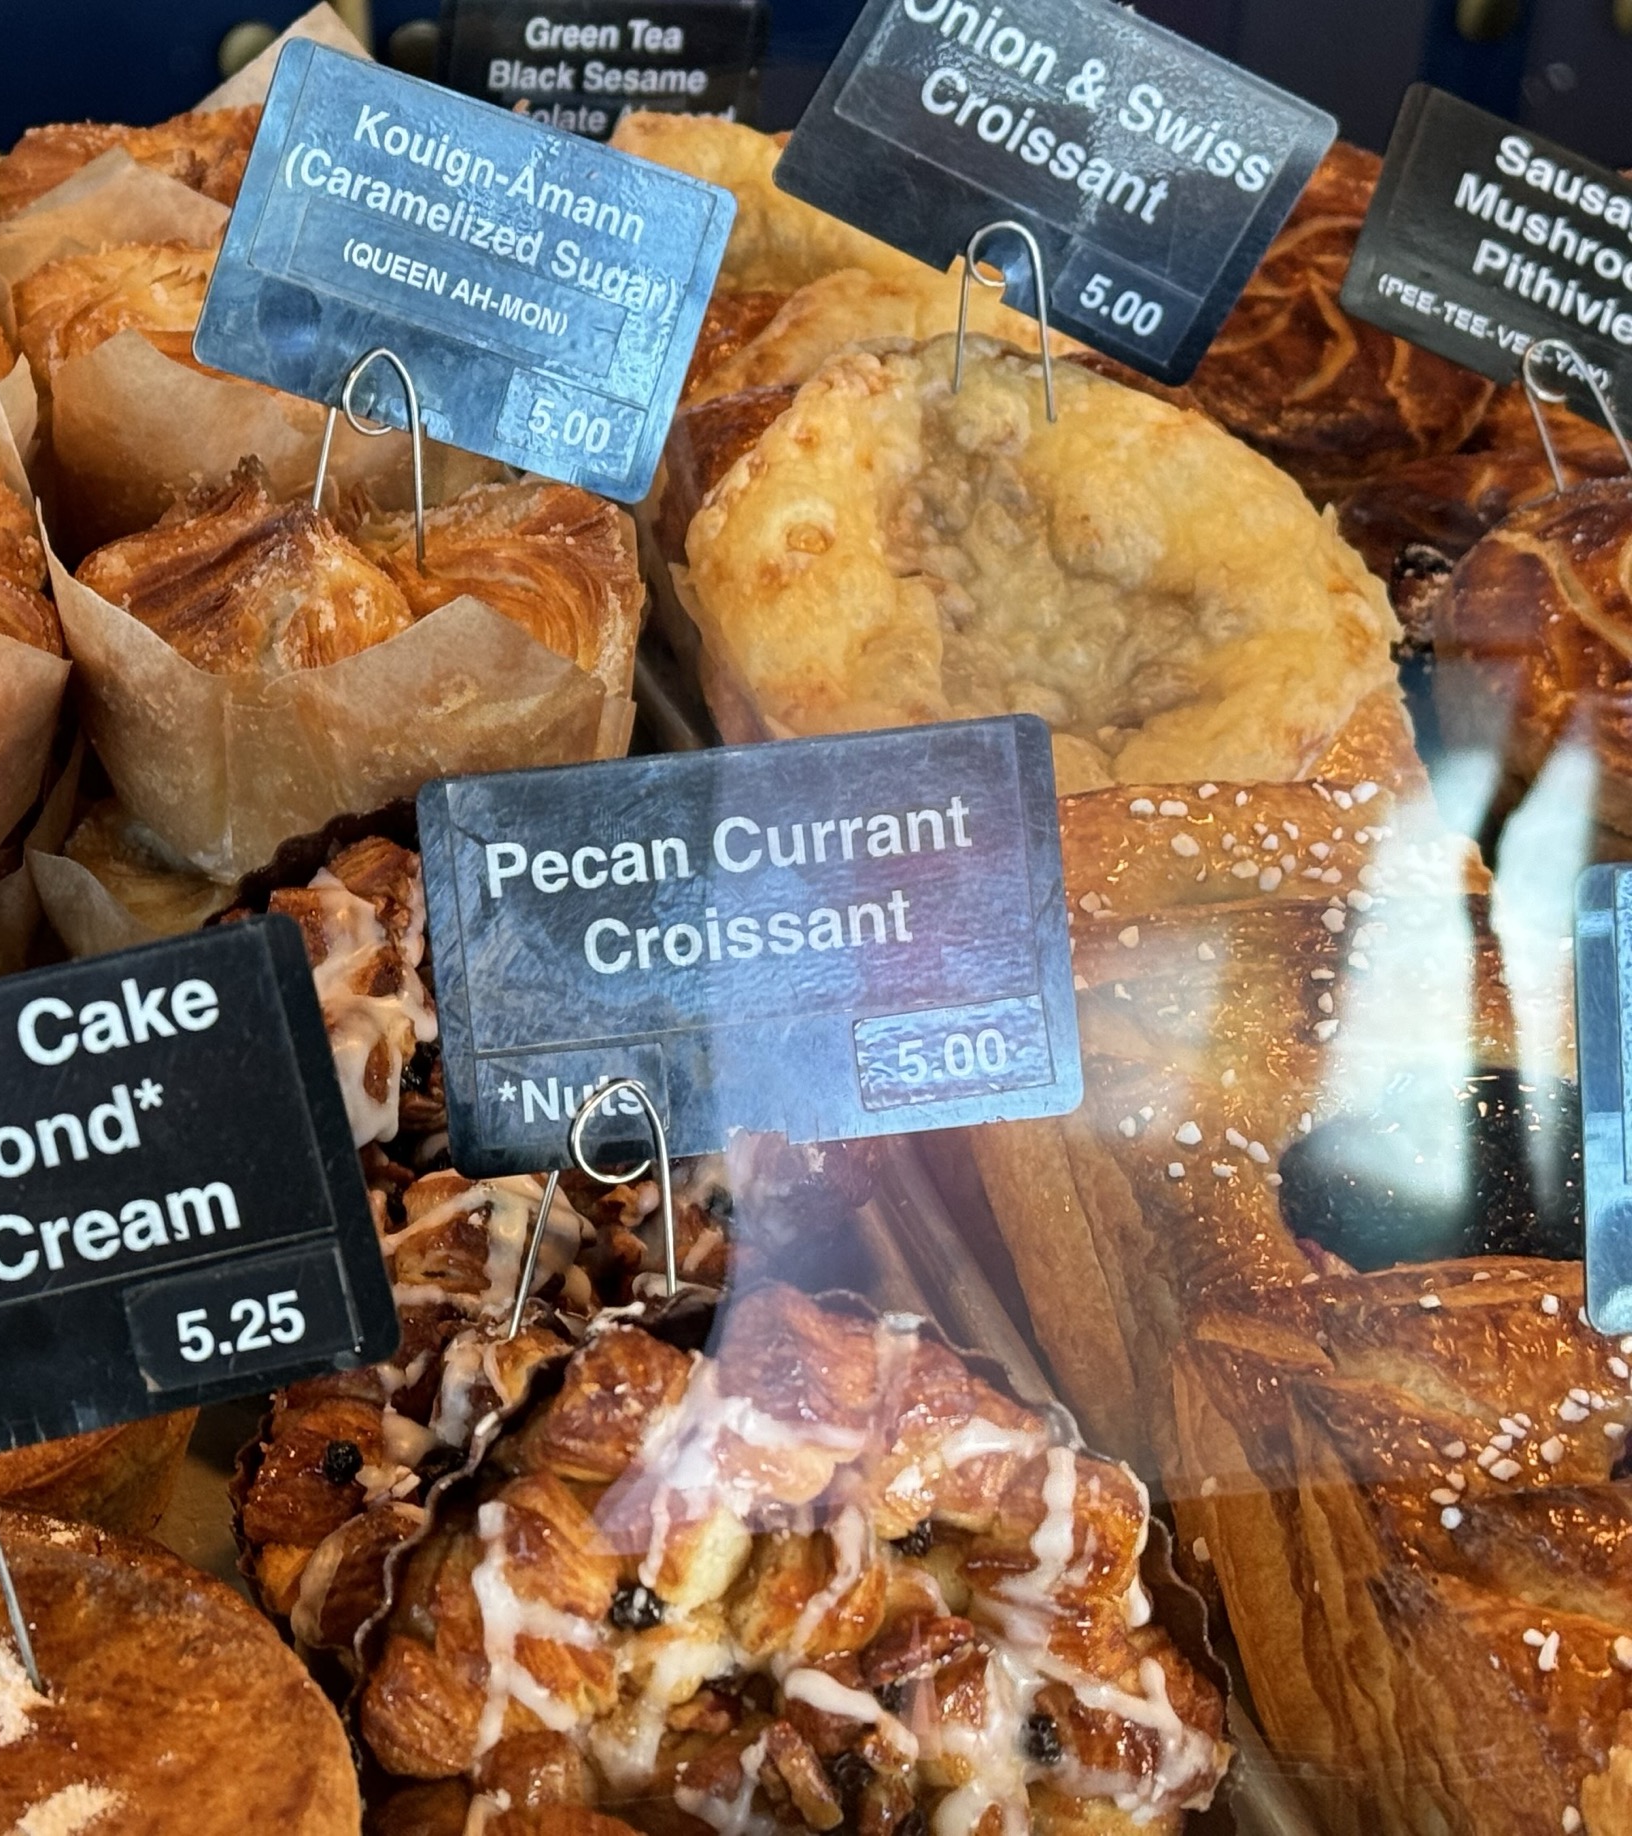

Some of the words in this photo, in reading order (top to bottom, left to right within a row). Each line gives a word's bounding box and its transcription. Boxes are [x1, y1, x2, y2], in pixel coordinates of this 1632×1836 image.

[488, 59, 574, 91] Black
[582, 60, 708, 95] Sesame
[525, 16, 619, 50] Green
[627, 18, 684, 53] Tea
[528, 103, 609, 134] olate
[903, 0, 1058, 85] Onion
[1065, 58, 1107, 110] &
[1118, 83, 1272, 193] Swiss
[351, 105, 646, 244] Kouign-Amann
[920, 66, 1170, 225] Croissant
[1495, 135, 1632, 243] Sausa
[284, 142, 544, 266] (Caramelized
[551, 239, 679, 325] Sugar)
[342, 238, 448, 296] (QUEEN
[450, 281, 569, 337] AH-MON)
[1079, 273, 1164, 337] 5.00
[527, 398, 612, 455] 5.00
[485, 834, 691, 899] Pecan
[712, 796, 974, 874] Currant
[583, 889, 914, 975] Croissant
[17, 976, 221, 1066] Cake
[895, 1028, 1008, 1084] 5.00
[176, 1290, 307, 1363] 5.25
